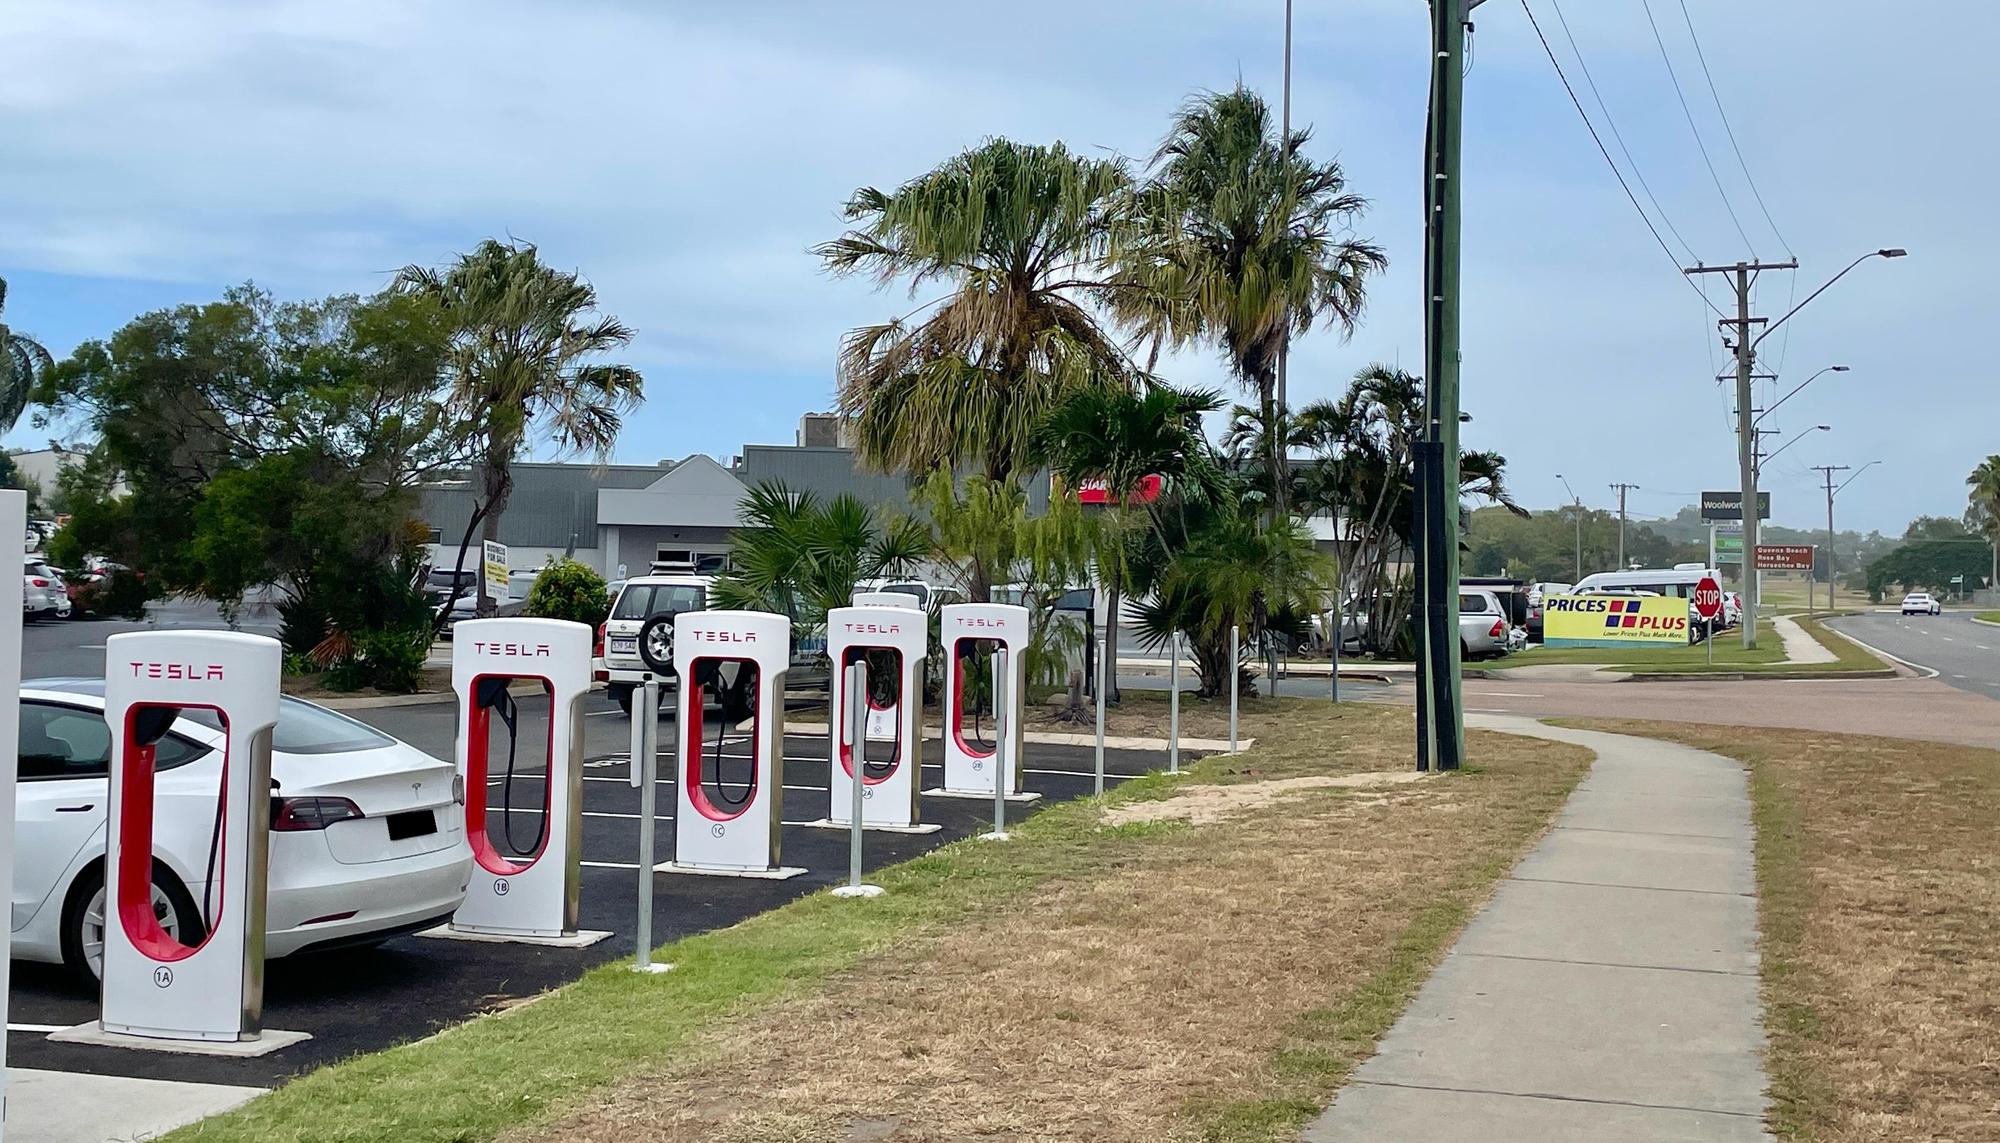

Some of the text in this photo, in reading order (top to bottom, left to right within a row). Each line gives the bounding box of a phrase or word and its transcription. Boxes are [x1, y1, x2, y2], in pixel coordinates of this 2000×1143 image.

[1703, 500, 1743, 510] Woolwort
[1796, 562, 1810, 570] Bay
[1696, 592, 1719, 606] STOP
[1546, 599, 1607, 612] PRICES
[957, 618, 1005, 627] TESLA
[1639, 617, 1686, 630] PLUS
[845, 623, 900, 634] TESLA
[1620, 630, 1638, 638] Prices
[693, 631, 756, 642] TESLA
[474, 643, 549, 656] TESLA
[130, 662, 223, 680] TESLA
[157, 971, 170, 982] 1A
